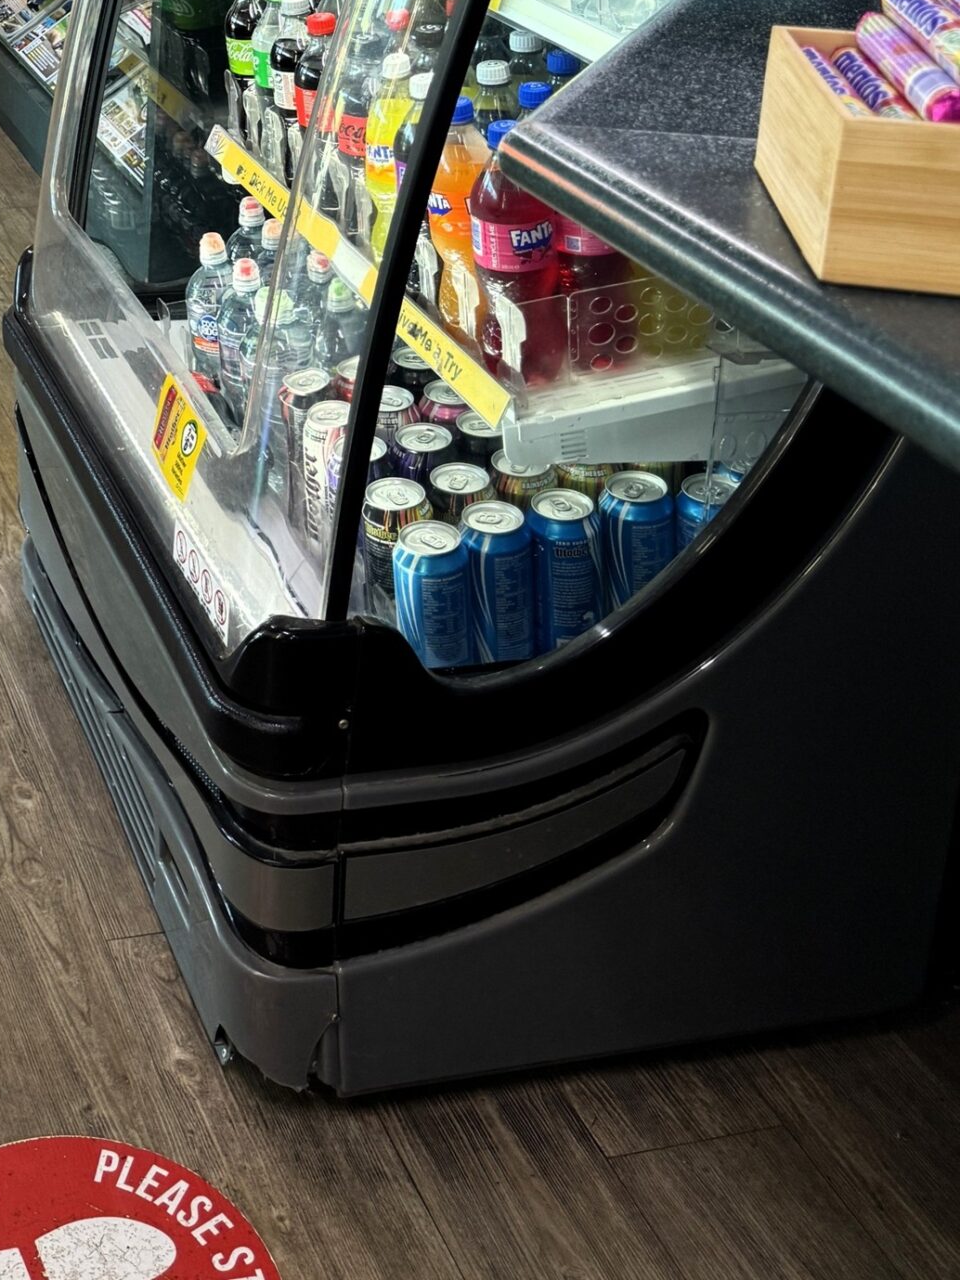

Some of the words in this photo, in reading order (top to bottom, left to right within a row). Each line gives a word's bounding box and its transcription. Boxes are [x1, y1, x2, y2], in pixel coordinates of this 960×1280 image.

[833, 50, 890, 110] mentos
[428, 194, 451, 210] NTA
[443, 351, 463, 381] Try
[93, 1148, 235, 1246] PLEASE
